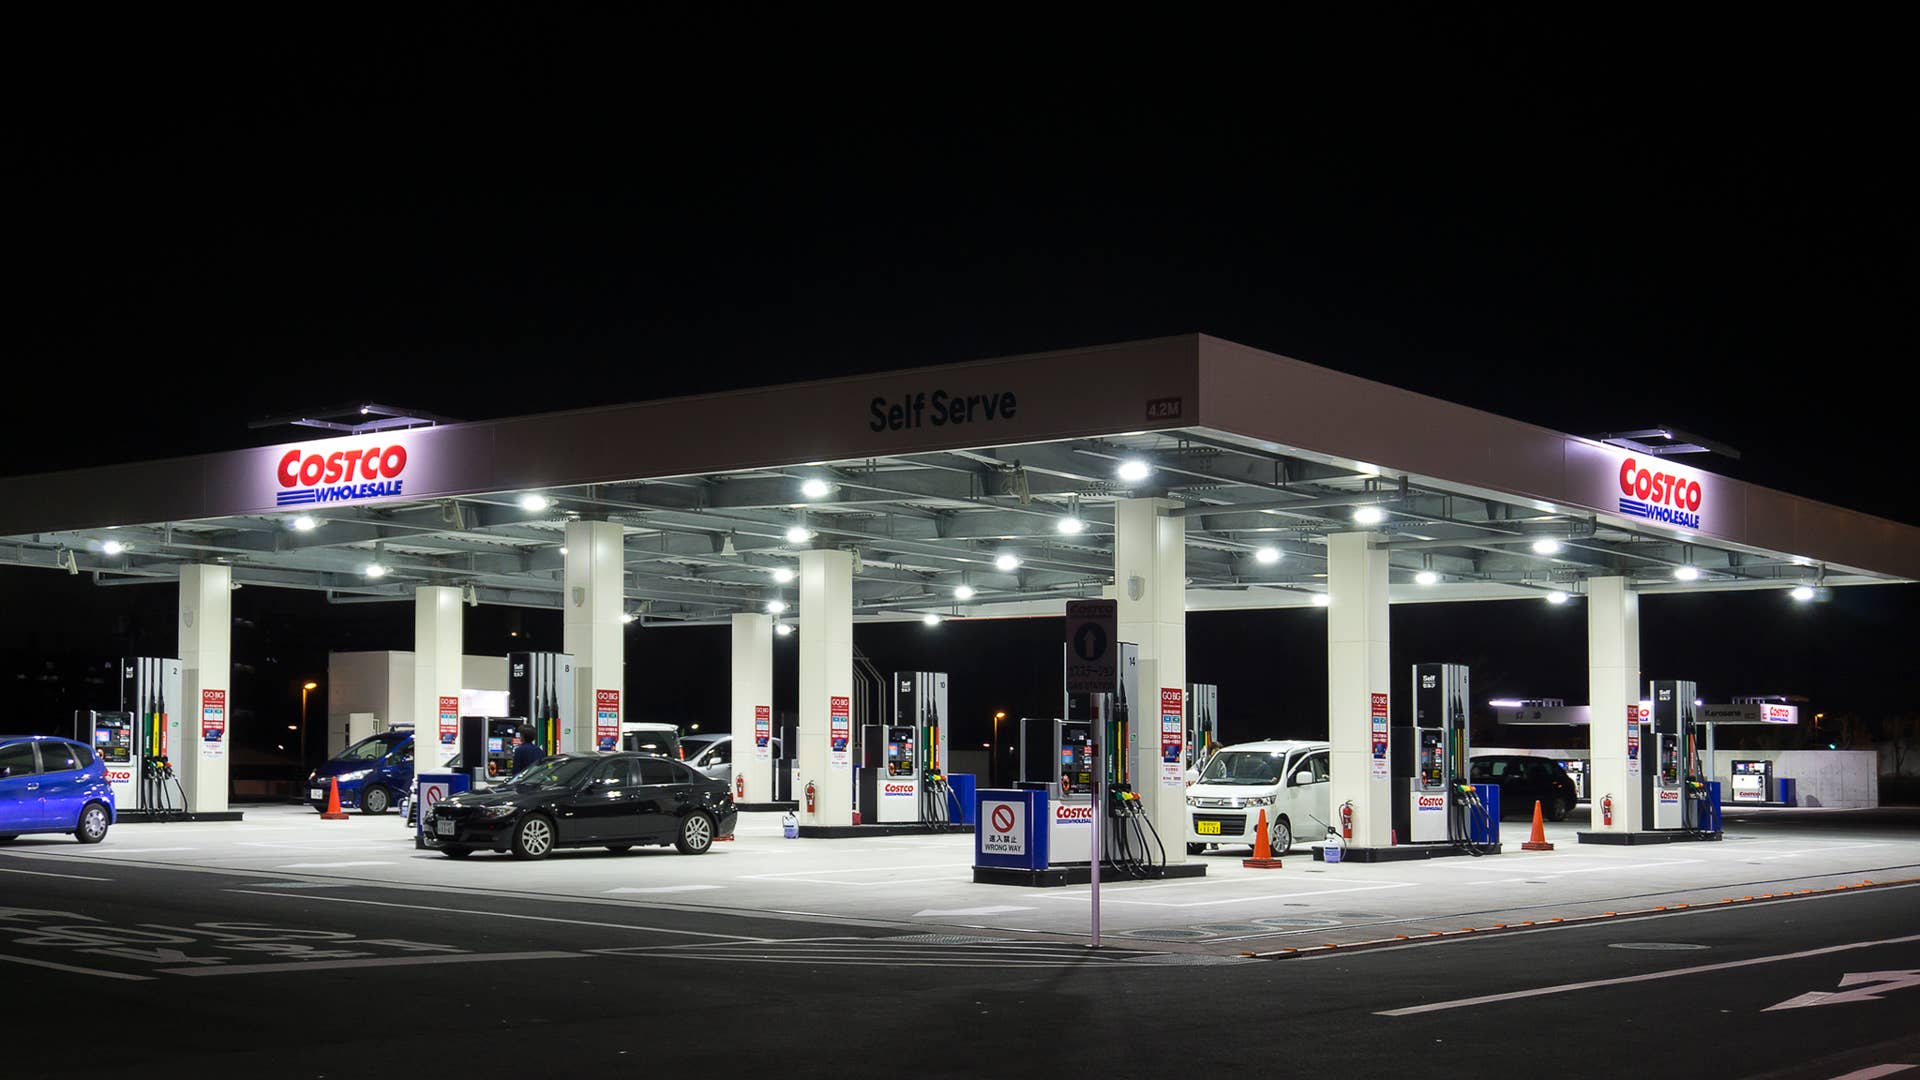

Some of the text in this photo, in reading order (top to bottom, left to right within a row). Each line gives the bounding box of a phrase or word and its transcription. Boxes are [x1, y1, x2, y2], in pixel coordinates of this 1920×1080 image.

[870, 390, 1017, 432] Self Serve
[1148, 401, 1180, 417] 4.2M
[277, 445, 407, 488] COSTCO
[1619, 457, 1702, 512] COSTCO
[315, 480, 403, 503] WHOLESALE
[1645, 503, 1700, 529] WHOLESALE
[1129, 656, 1136, 666] 14
[173, 667, 178, 675] 2
[565, 665, 570, 673] 8
[598, 692, 608, 700] GO
[1162, 691, 1172, 700] GO
[1769, 706, 1789, 718] COSTCO
[885, 783, 914, 792] COSTCO
[1419, 796, 1444, 806] COSTCO
[988, 834, 1017, 844] 進入禁止
[985, 843, 1021, 852] WRONG WAY
